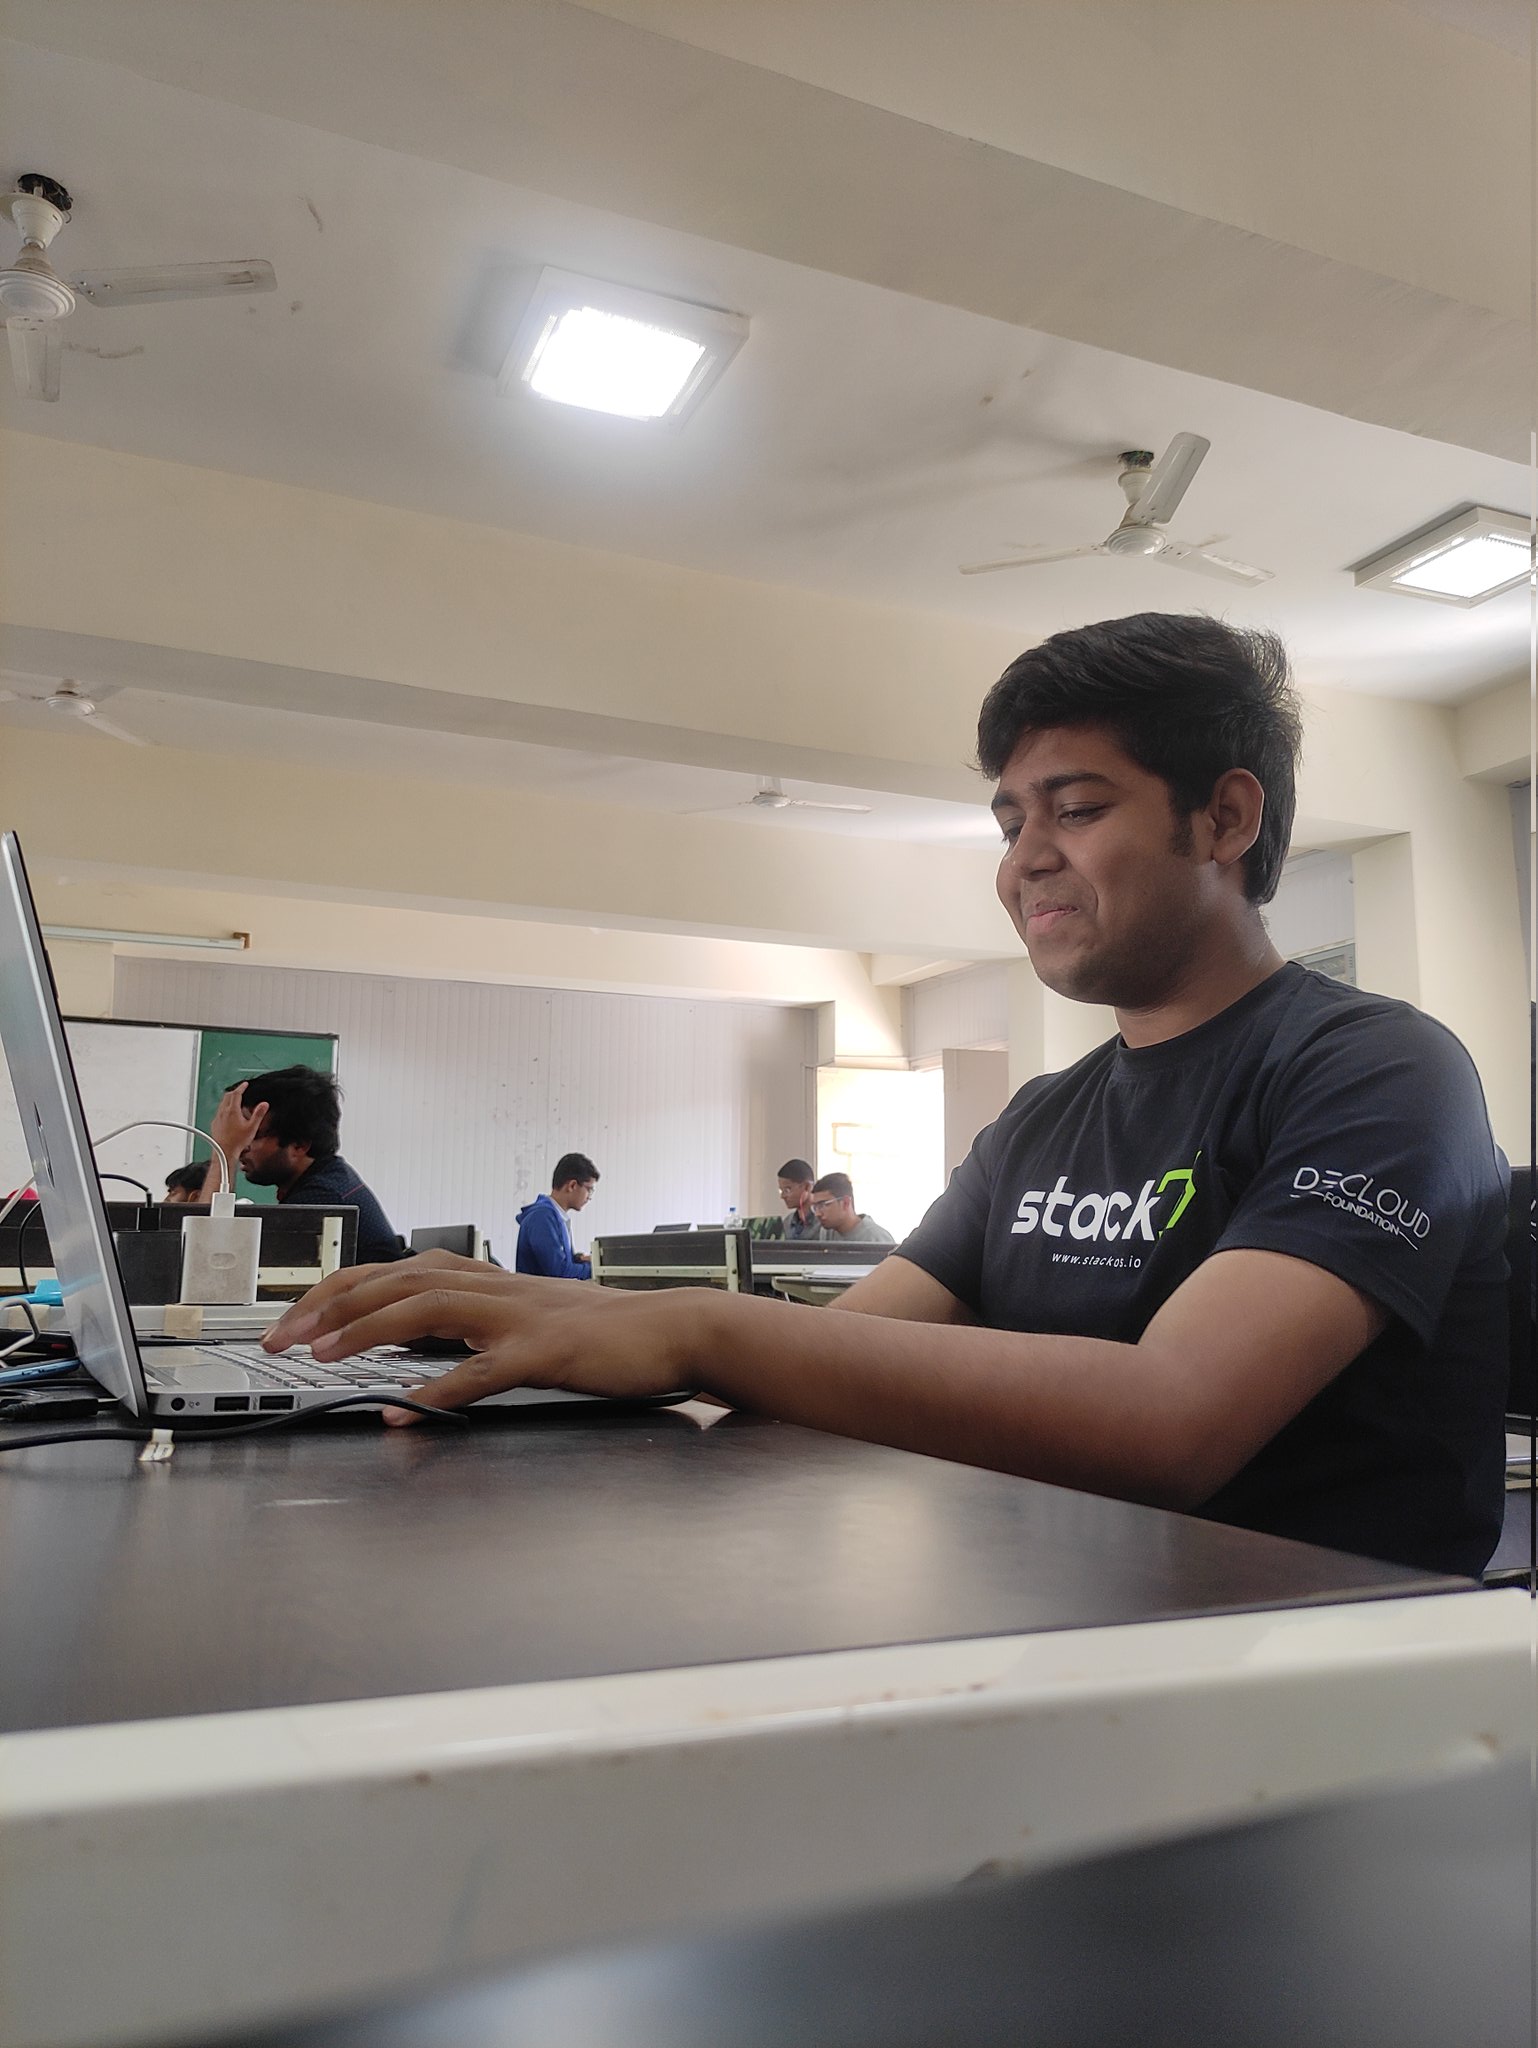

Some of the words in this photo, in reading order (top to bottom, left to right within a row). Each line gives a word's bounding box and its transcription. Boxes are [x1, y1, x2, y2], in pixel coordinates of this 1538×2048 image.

[1293, 1166, 1431, 1239] DECLOUD
[1323, 1192, 1400, 1237] FOUNDATION
[1051, 1252, 1142, 1269] www.stackos.io
